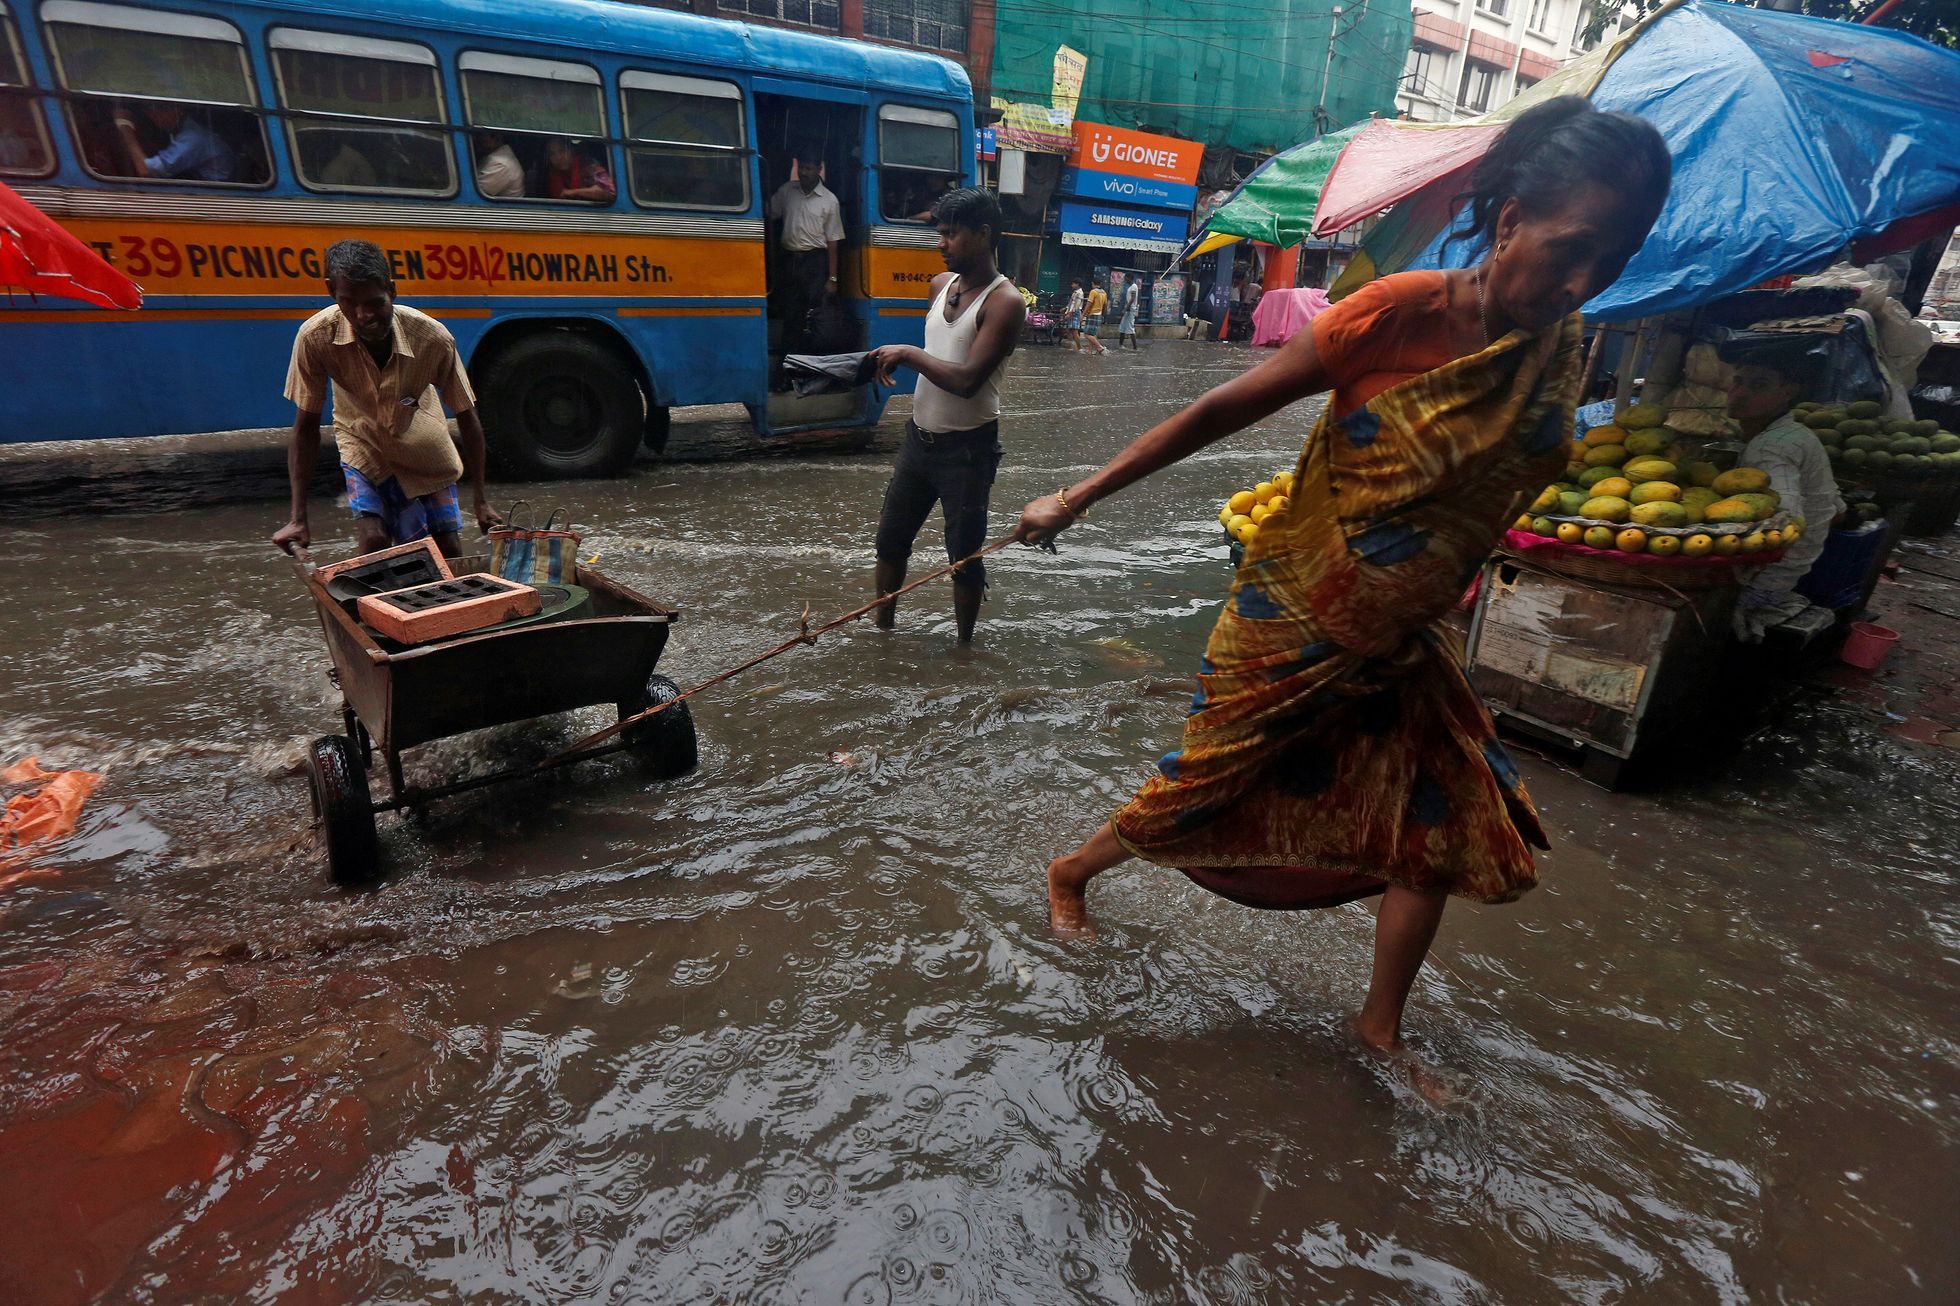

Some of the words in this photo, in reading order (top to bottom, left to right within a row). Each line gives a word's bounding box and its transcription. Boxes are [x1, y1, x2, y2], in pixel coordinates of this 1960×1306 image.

[1114, 143, 1178, 169] GIONEE
[1103, 179, 1134, 194] vivo
[1138, 187, 1153, 196] Smart
[1091, 213, 1133, 227] SAMSUNG
[1135, 218, 1163, 232] Galaxy
[119, 236, 182, 278] 39
[507, 252, 619, 282] HOWRAH
[626, 255, 673, 283] Stn.
